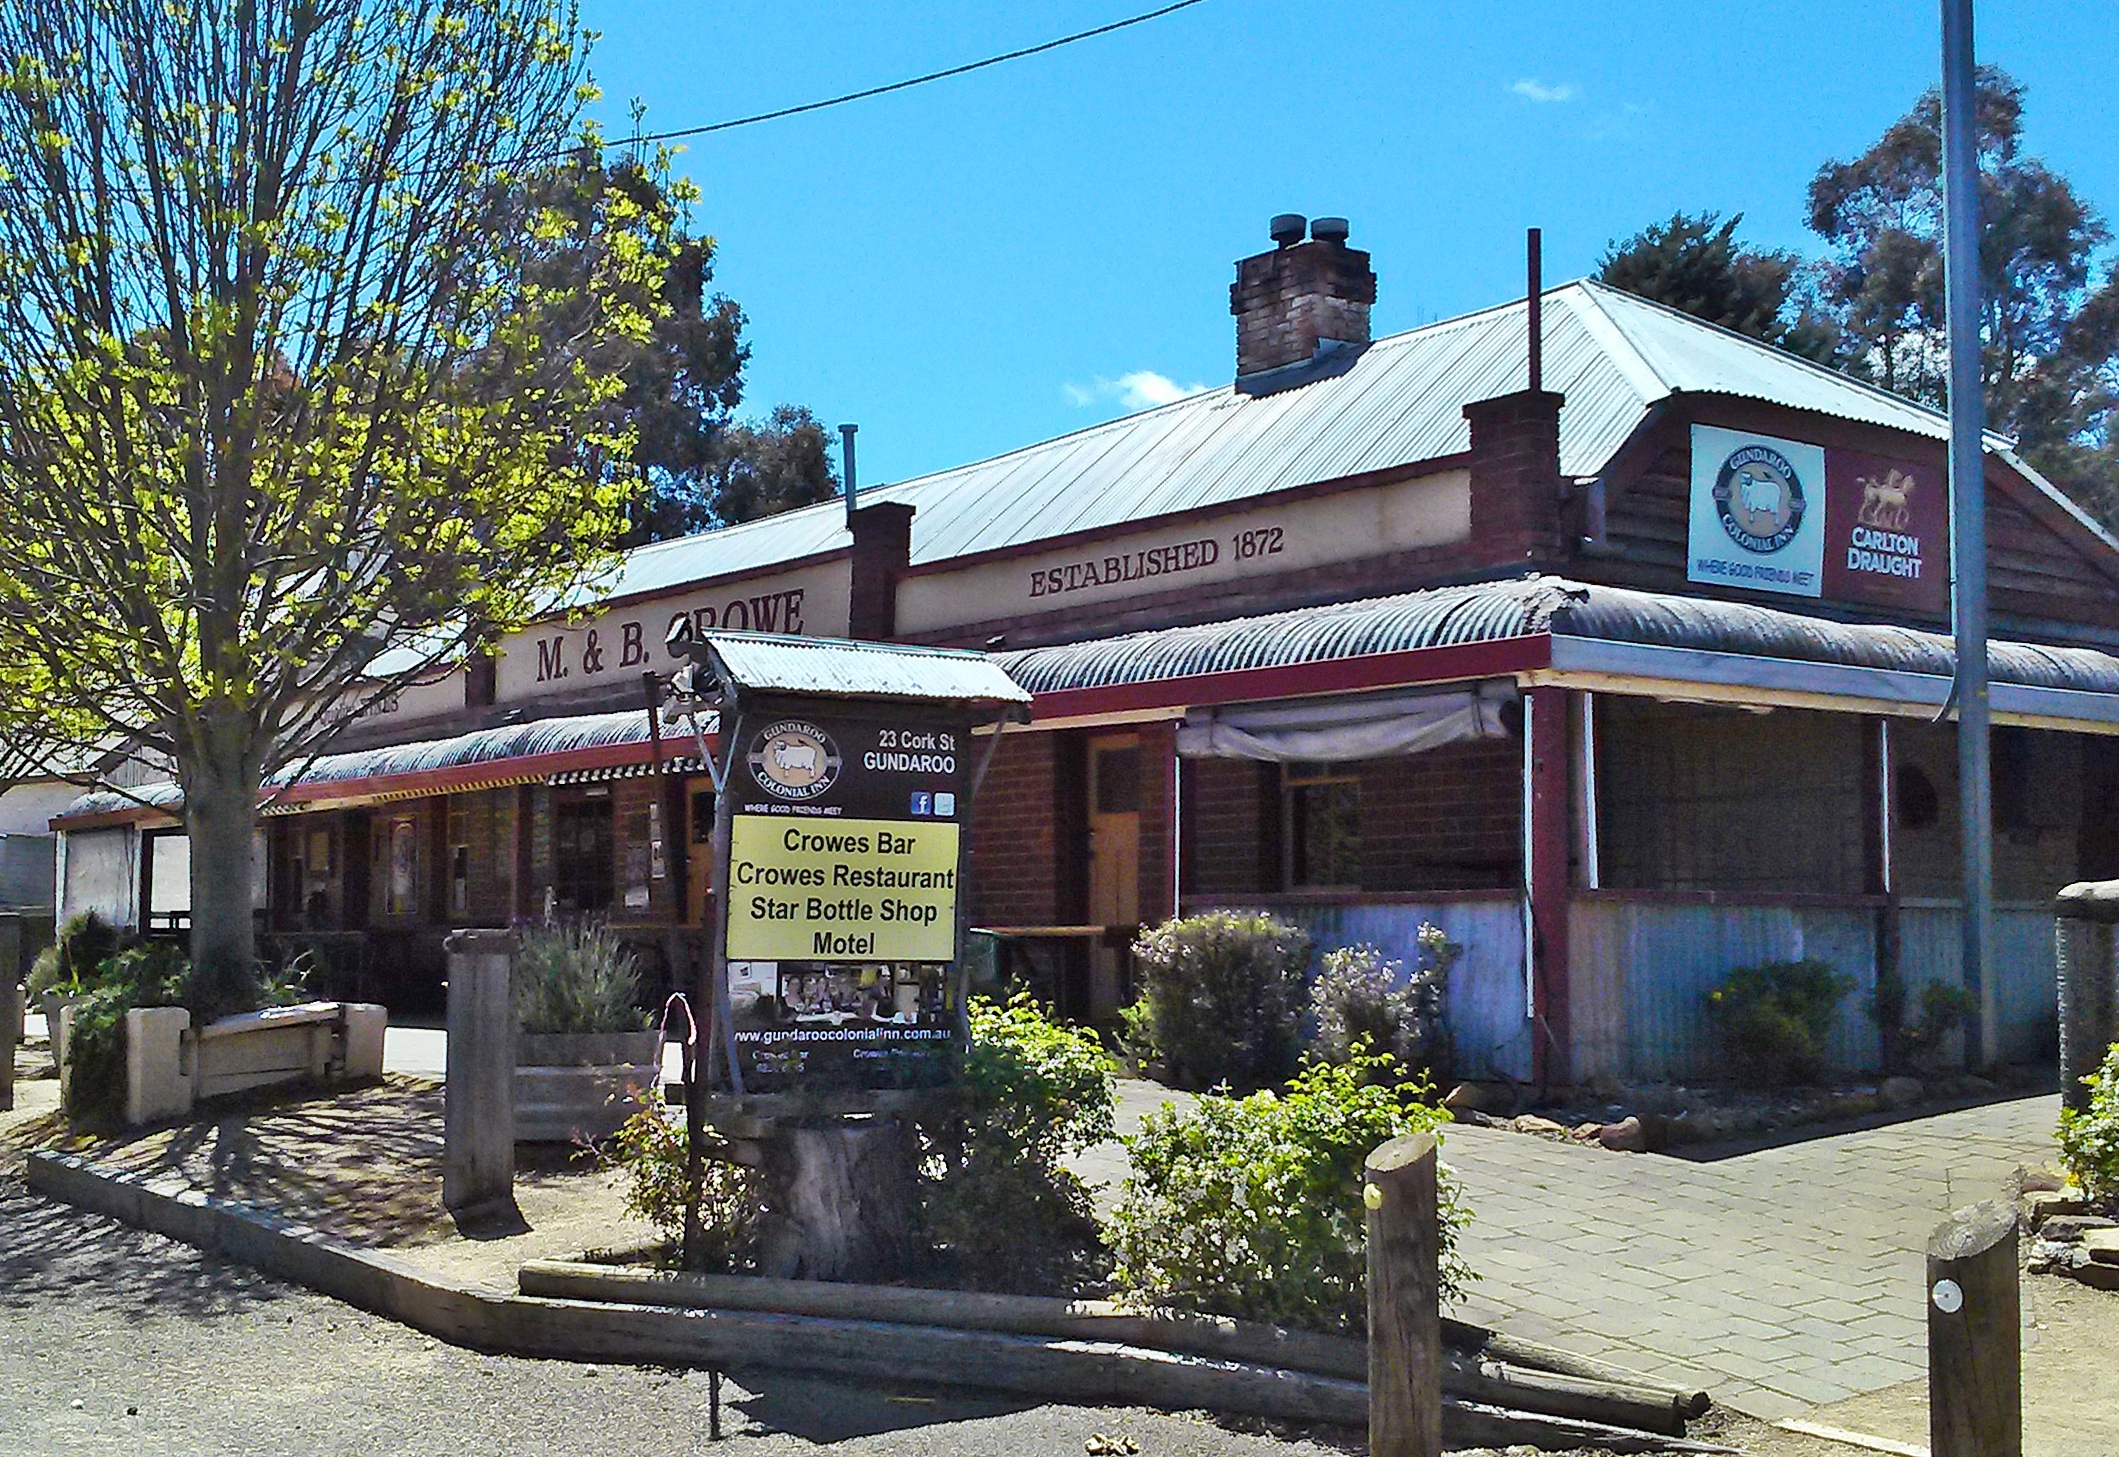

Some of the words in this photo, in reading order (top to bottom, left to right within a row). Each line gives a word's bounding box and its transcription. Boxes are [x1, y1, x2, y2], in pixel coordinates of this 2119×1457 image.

[1729, 449, 1792, 479] GUNDAROO
[1722, 513, 1777, 552] COLONIAL
[1852, 526, 1919, 556] CARLTON
[1029, 539, 1219, 598] ESTABLISHED
[1232, 527, 1285, 561] 1872
[1847, 547, 1922, 579] DRAUGHT
[537, 636, 569, 682] M.
[583, 629, 604, 674] &
[619, 621, 650, 668] B.
[763, 722, 827, 745] GUNDAROO
[879, 729, 897, 748] 23
[901, 730, 936, 750] Cork
[939, 733, 956, 751] St
[864, 751, 956, 774] GUNDAROO
[757, 771, 810, 797] COLONIAL
[811, 774, 831, 794] INN
[744, 803, 769, 813] WHERE
[770, 804, 791, 814] GOOD
[792, 805, 822, 815] FRIENDS
[823, 806, 842, 816] MEET
[783, 828, 870, 853] Crowes
[877, 832, 916, 855] Bar
[737, 861, 825, 886] Crowes
[833, 864, 954, 889] Restaurant
[750, 896, 799, 920] Star
[806, 898, 873, 921] Bottle
[880, 898, 938, 927] Shop
[813, 932, 875, 955] Motel
